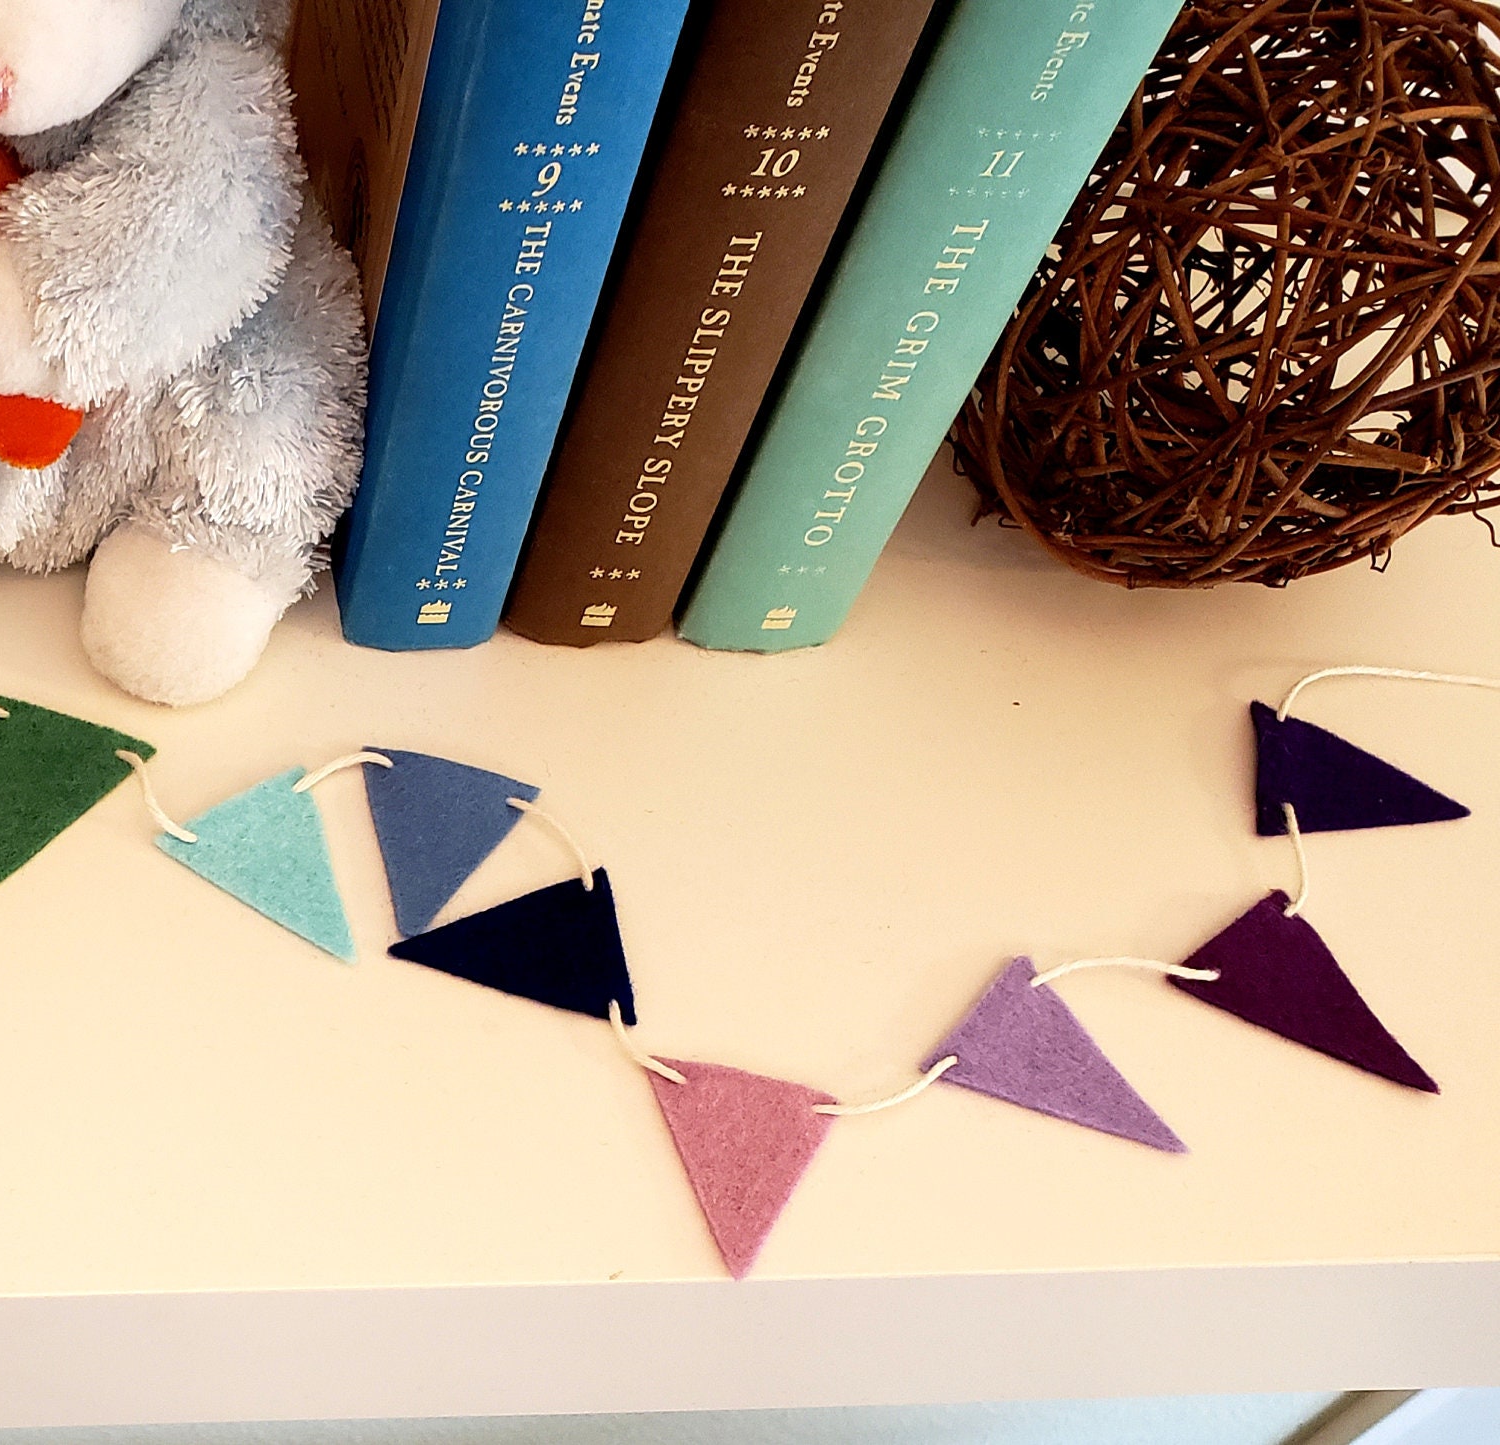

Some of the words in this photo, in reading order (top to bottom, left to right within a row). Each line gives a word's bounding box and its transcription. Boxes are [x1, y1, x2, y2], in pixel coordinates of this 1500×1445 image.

[555, 51, 601, 125] Events
[786, 31, 840, 107] Events
[1030, 31, 1090, 102] Events
[531, 161, 562, 197] 9
[750, 148, 800, 178] 10
[978, 150, 1025, 178] 11
[515, 221, 552, 275] THE
[710, 231, 763, 298] THE
[923, 219, 990, 295] THE
[465, 283, 534, 463] CARNIVOROUS
[653, 308, 731, 449] SLIPPERY
[871, 311, 939, 401] GRIM
[615, 457, 672, 545] SLOPE
[804, 416, 888, 546] GROTTO
[435, 470, 483, 576] CARNIVAL
